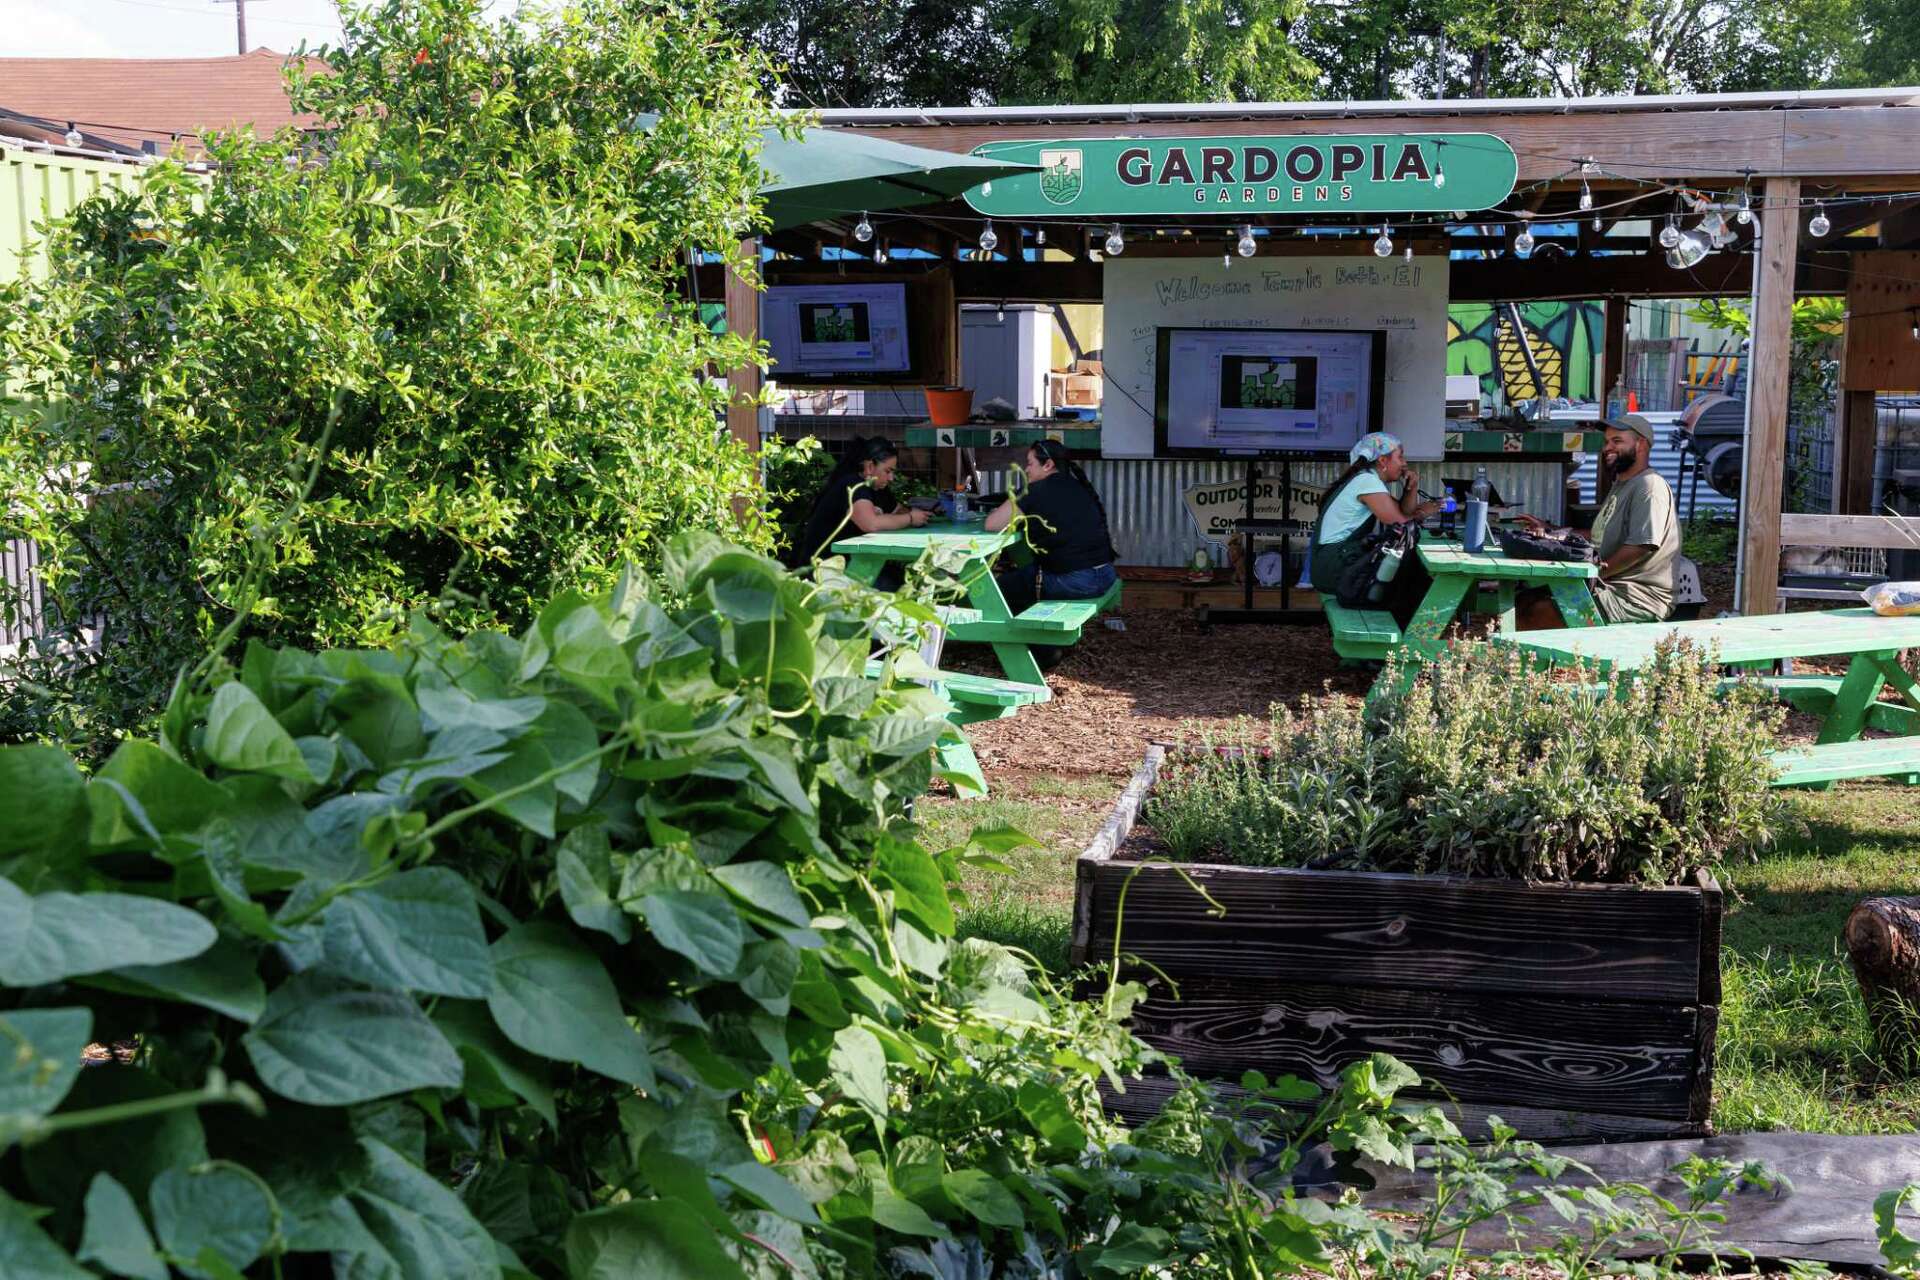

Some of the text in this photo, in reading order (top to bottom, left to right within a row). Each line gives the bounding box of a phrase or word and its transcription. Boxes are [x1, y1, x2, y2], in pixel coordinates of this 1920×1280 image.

[1116, 143, 1432, 186] GARDOPIA
[1194, 186, 1352, 203] GARDENS
[1156, 276, 1251, 305] Welcome
[1263, 265, 1321, 294] Temple
